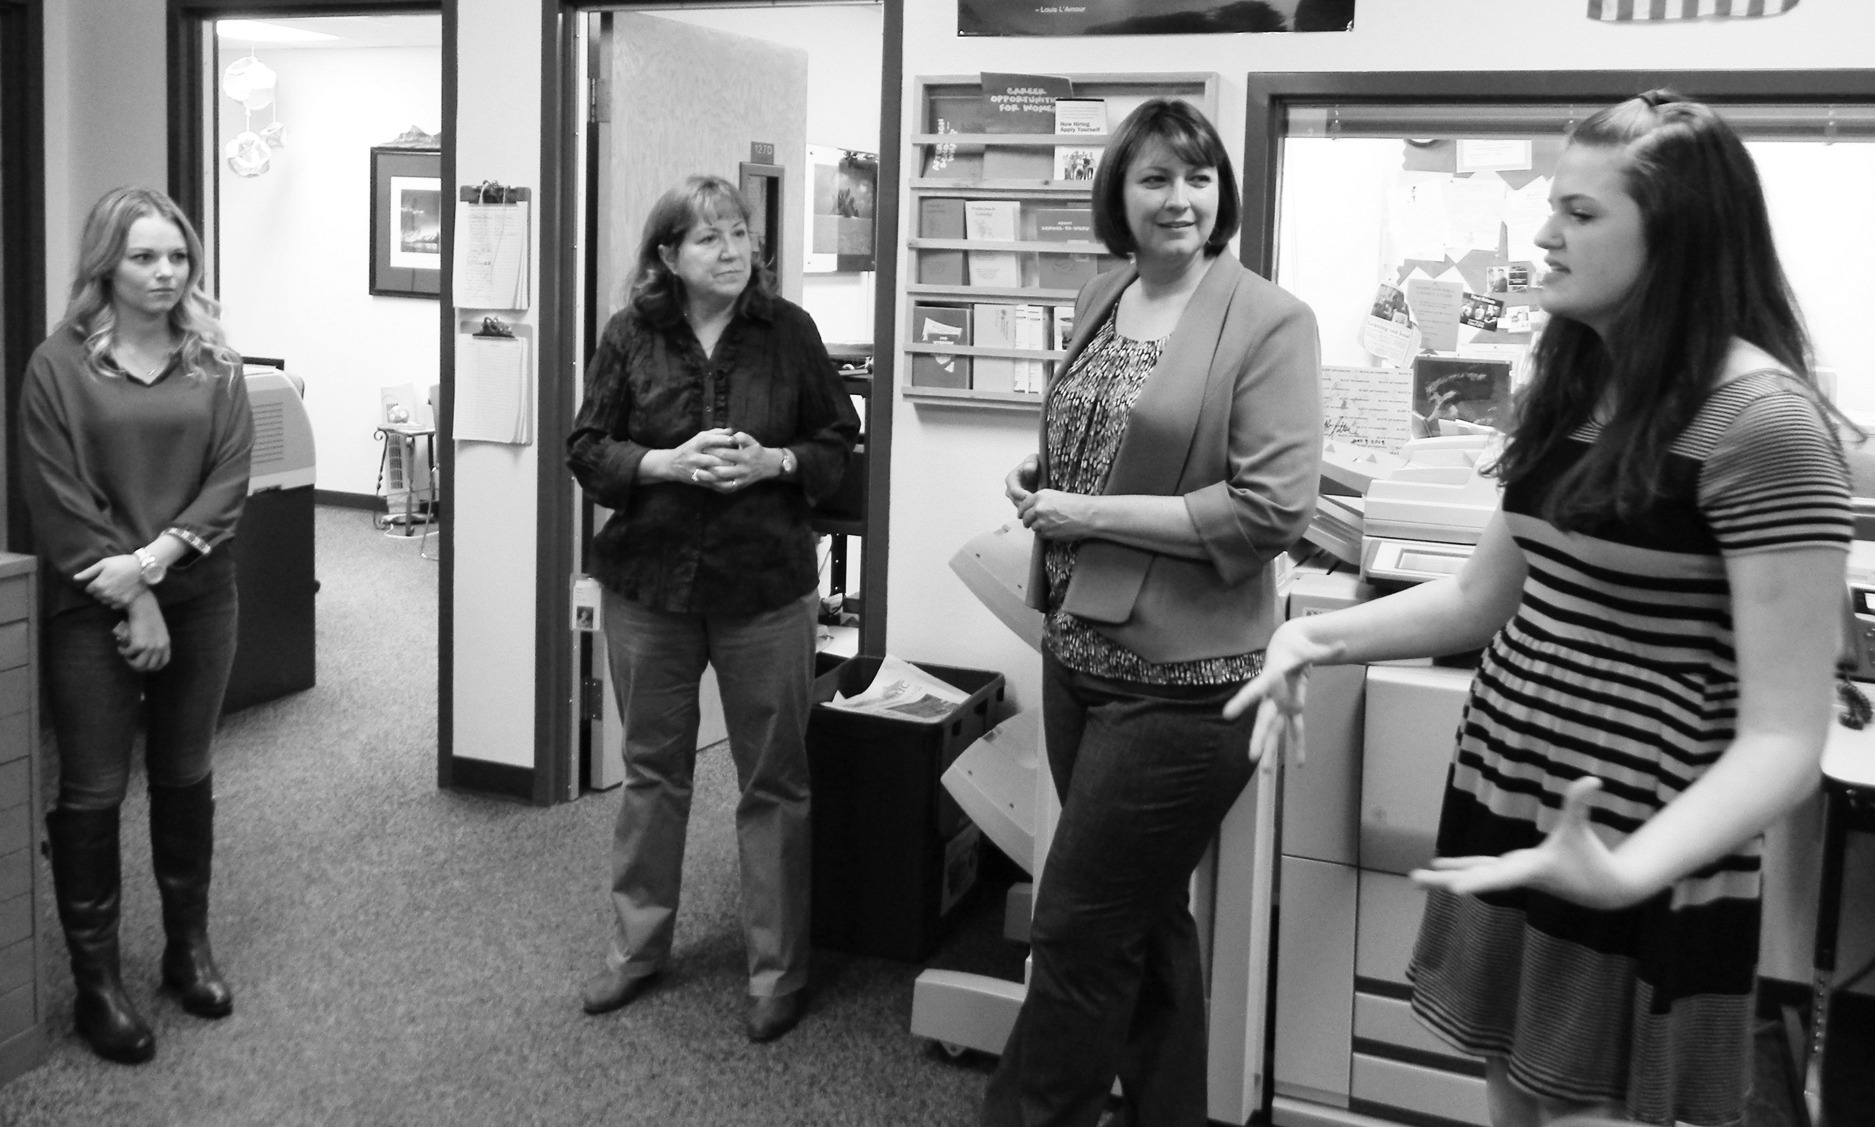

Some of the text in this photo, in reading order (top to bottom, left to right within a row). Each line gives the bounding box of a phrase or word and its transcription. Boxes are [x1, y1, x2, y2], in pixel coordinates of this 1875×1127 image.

[1040, 5, 1058, 13] Louis
[1058, 5, 1087, 13] L'Amour
[1006, 87, 1048, 95] CAREER
[999, 103, 1021, 113] FOR
